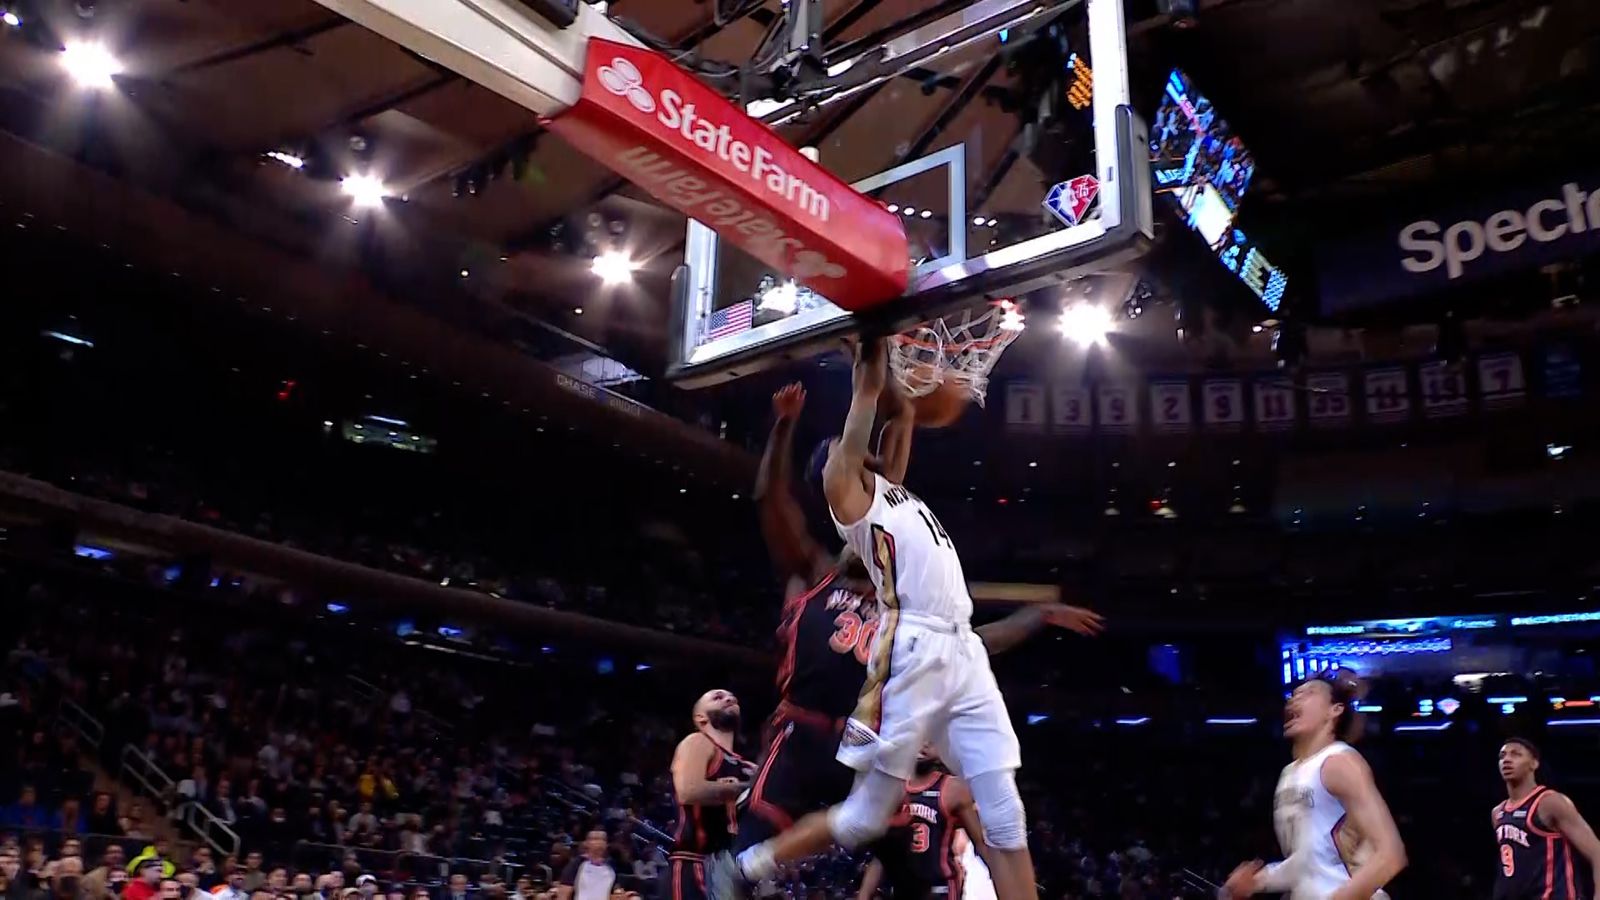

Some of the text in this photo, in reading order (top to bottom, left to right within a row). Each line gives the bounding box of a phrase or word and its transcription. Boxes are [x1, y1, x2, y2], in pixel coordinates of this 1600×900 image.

[918, 509, 952, 549] 14
[829, 610, 880, 665] 30
[911, 823, 930, 853] 3
[1501, 844, 1514, 877] 9
